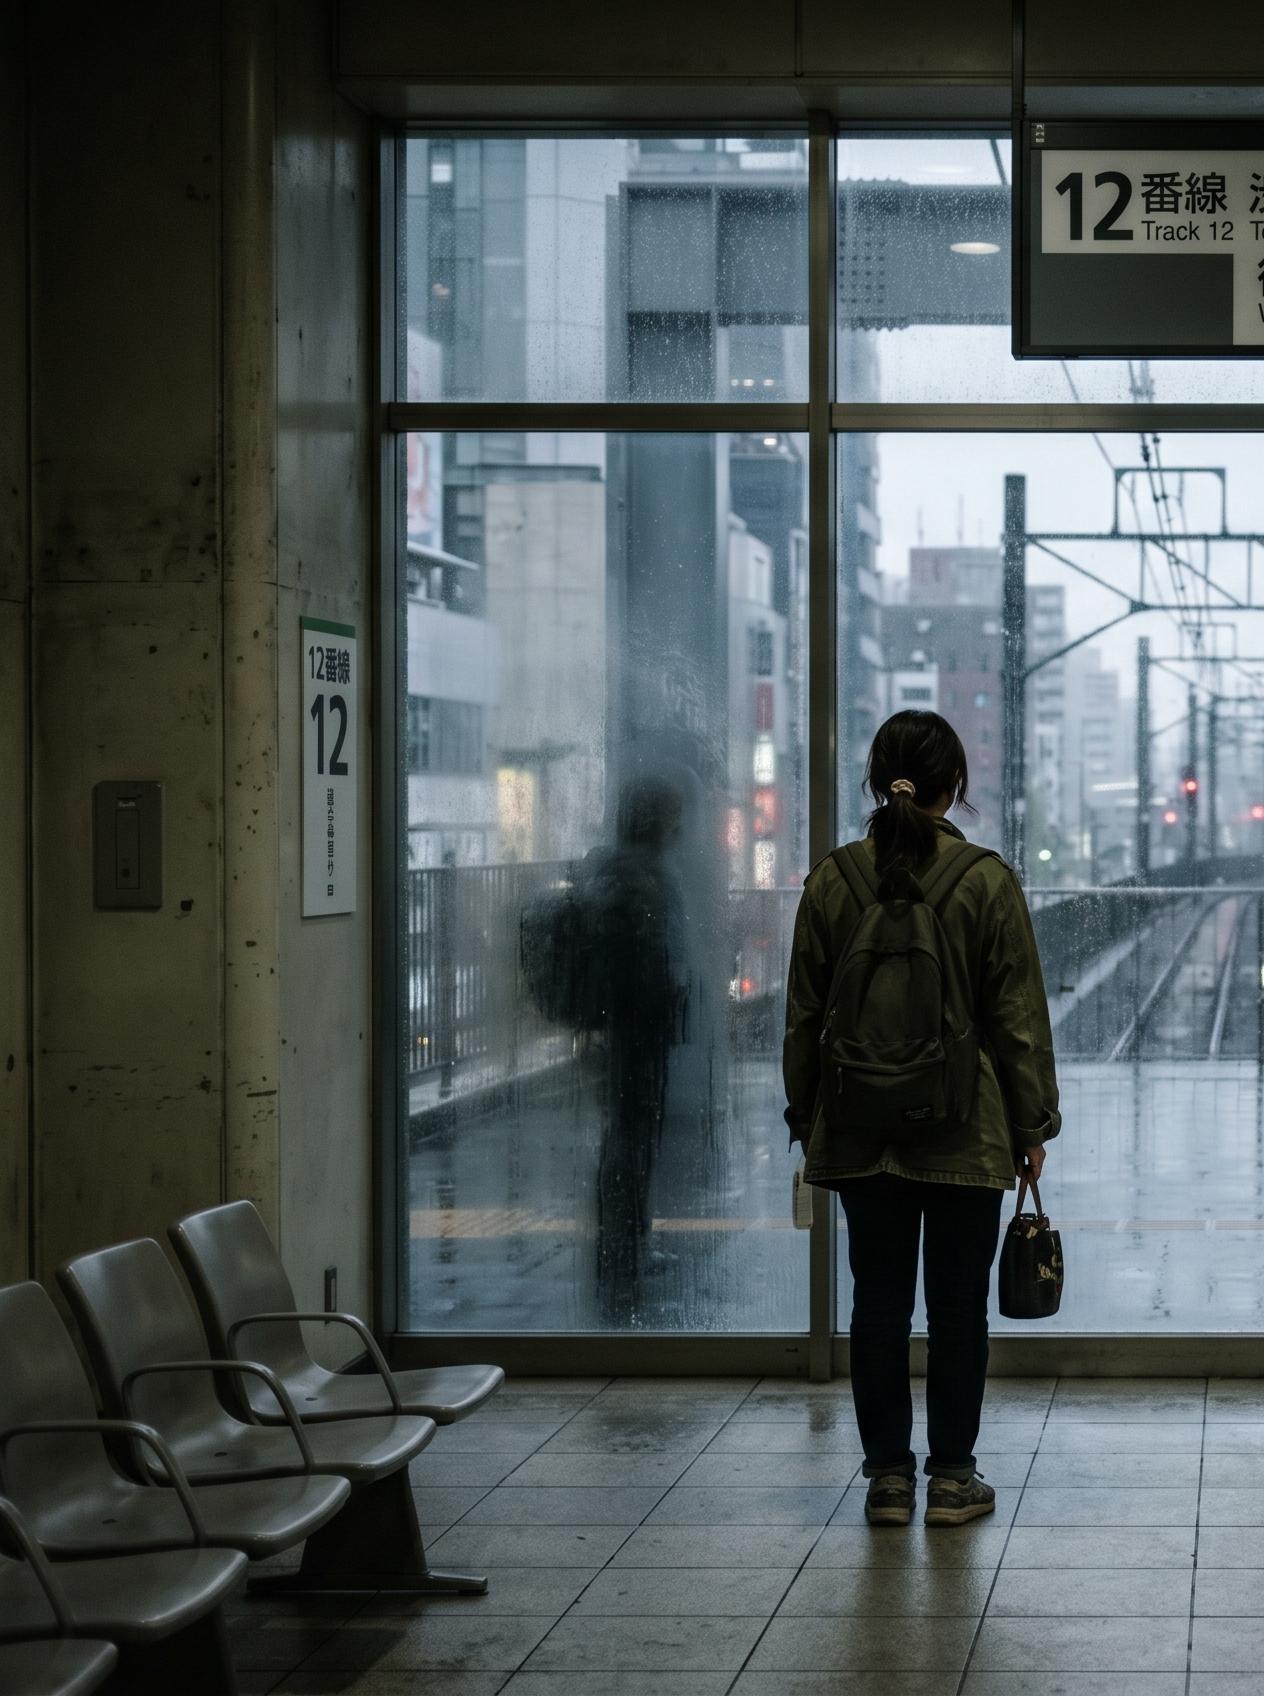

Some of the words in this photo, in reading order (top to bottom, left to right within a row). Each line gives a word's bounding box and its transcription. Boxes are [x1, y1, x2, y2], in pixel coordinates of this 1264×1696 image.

[1056, 171, 1133, 240] 12
[1141, 172, 1227, 214] 番線
[1142, 221, 1200, 240] Track
[1210, 221, 1233, 240] 12
[310, 694, 349, 775] 12
